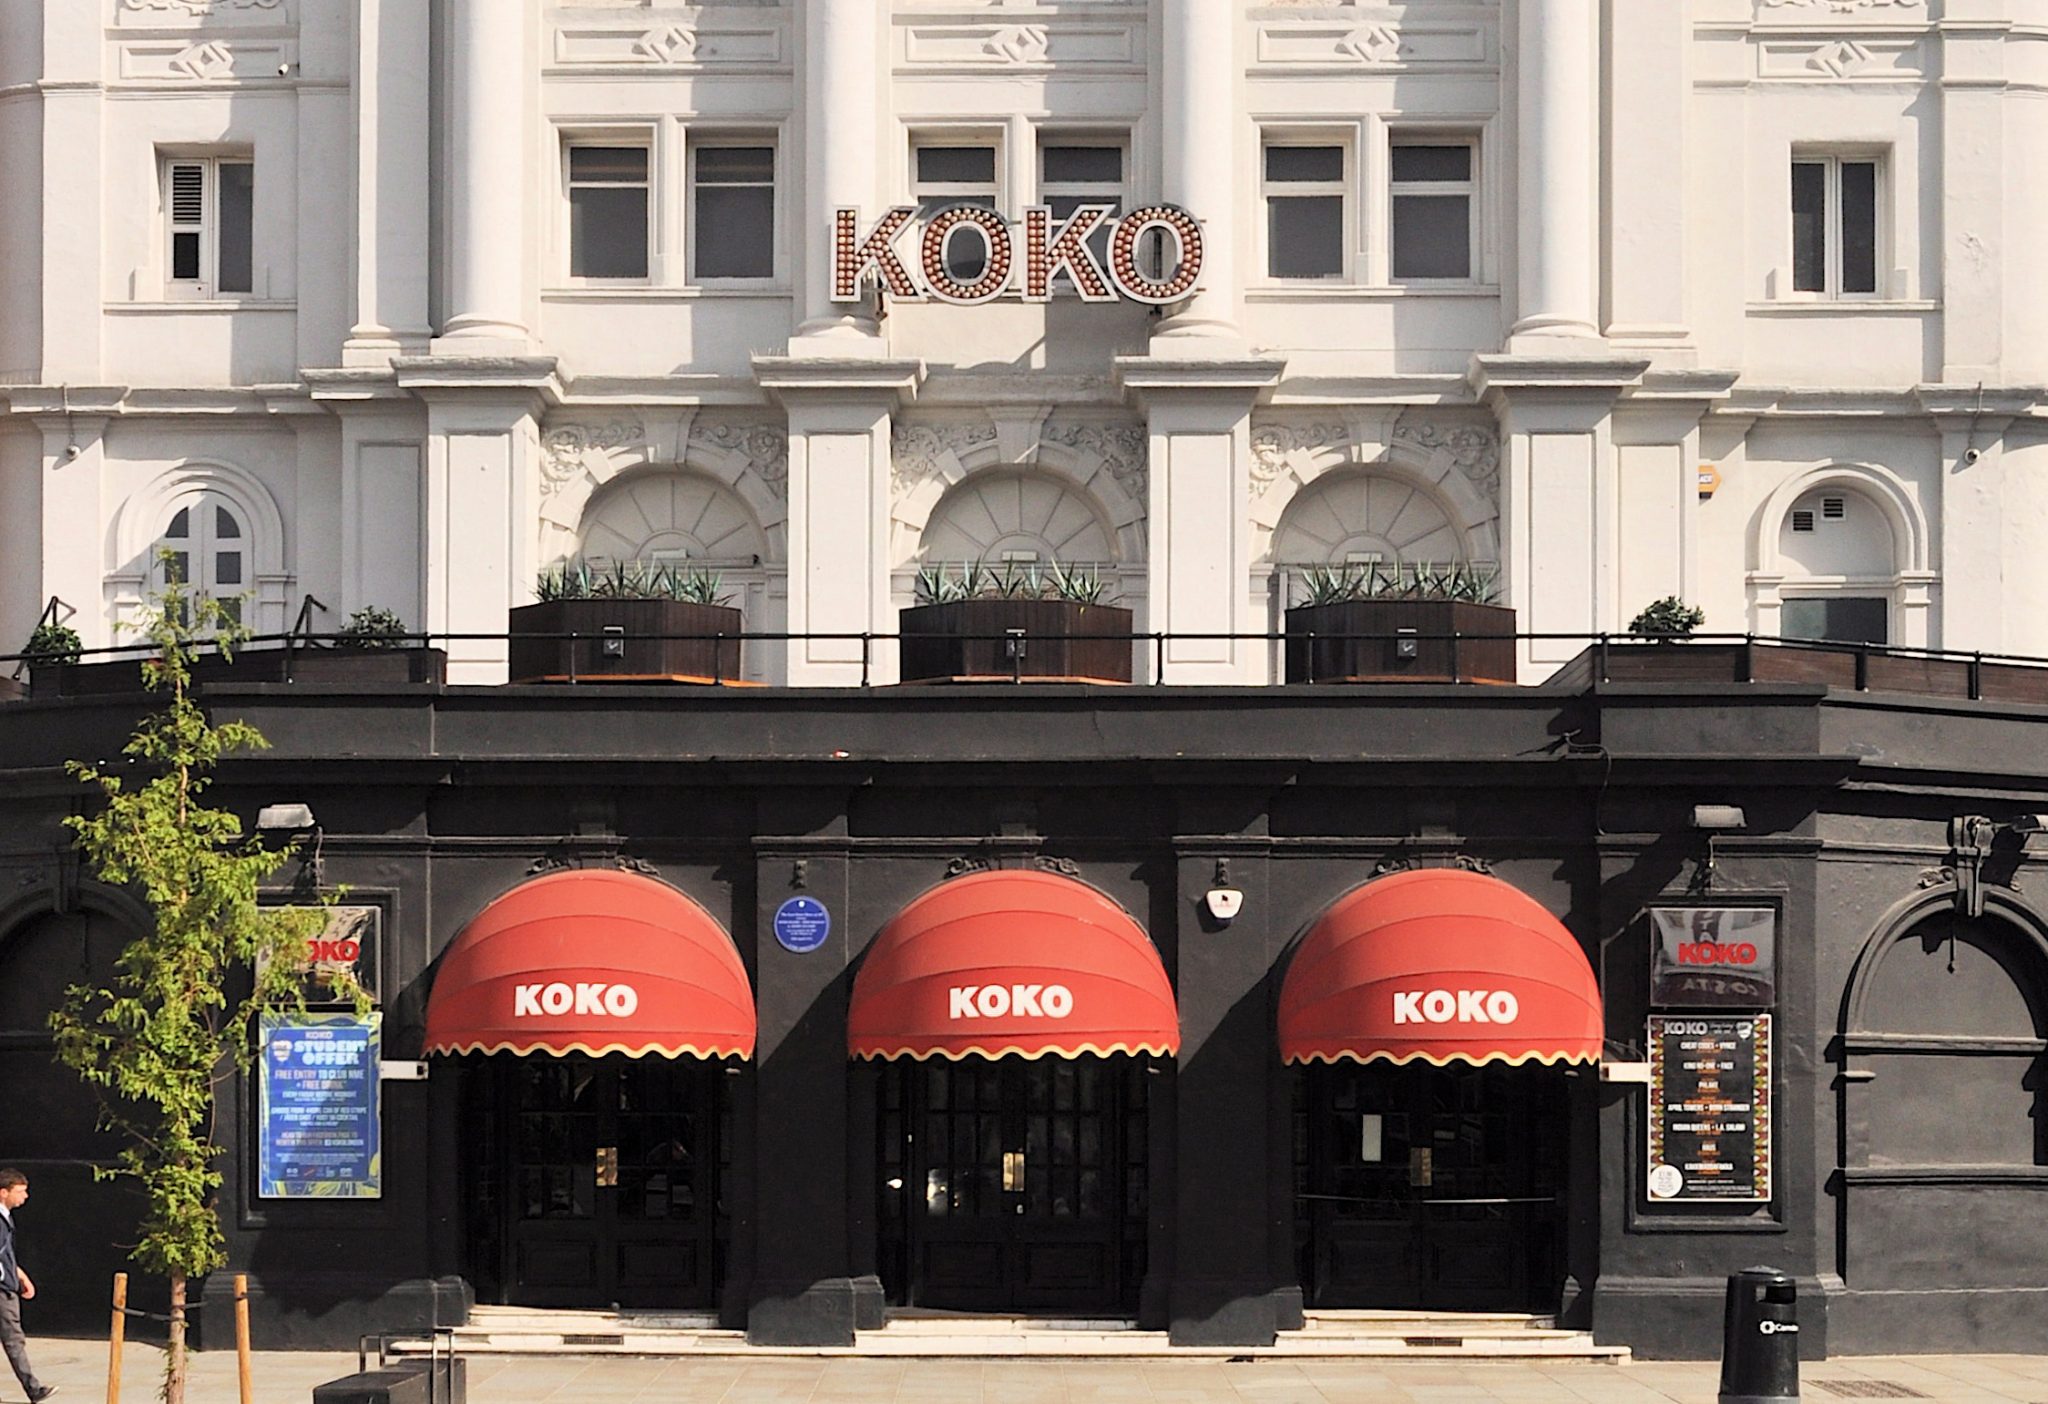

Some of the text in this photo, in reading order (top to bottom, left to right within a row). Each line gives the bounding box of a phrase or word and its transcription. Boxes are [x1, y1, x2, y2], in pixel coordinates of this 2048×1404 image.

[830, 203, 1207, 305] KOKO
[304, 940, 360, 962] OKO
[1678, 942, 1757, 965] KOKO
[514, 982, 638, 1018] KOKO
[949, 984, 1074, 1019] KOKO
[1393, 990, 1519, 1025] KOKO
[1664, 1022, 1708, 1034] KOKO
[294, 1040, 367, 1052] STUDENT
[302, 1052, 359, 1065] OFFER
[275, 1069, 292, 1079] FREE
[293, 1069, 316, 1079] ENTRY
